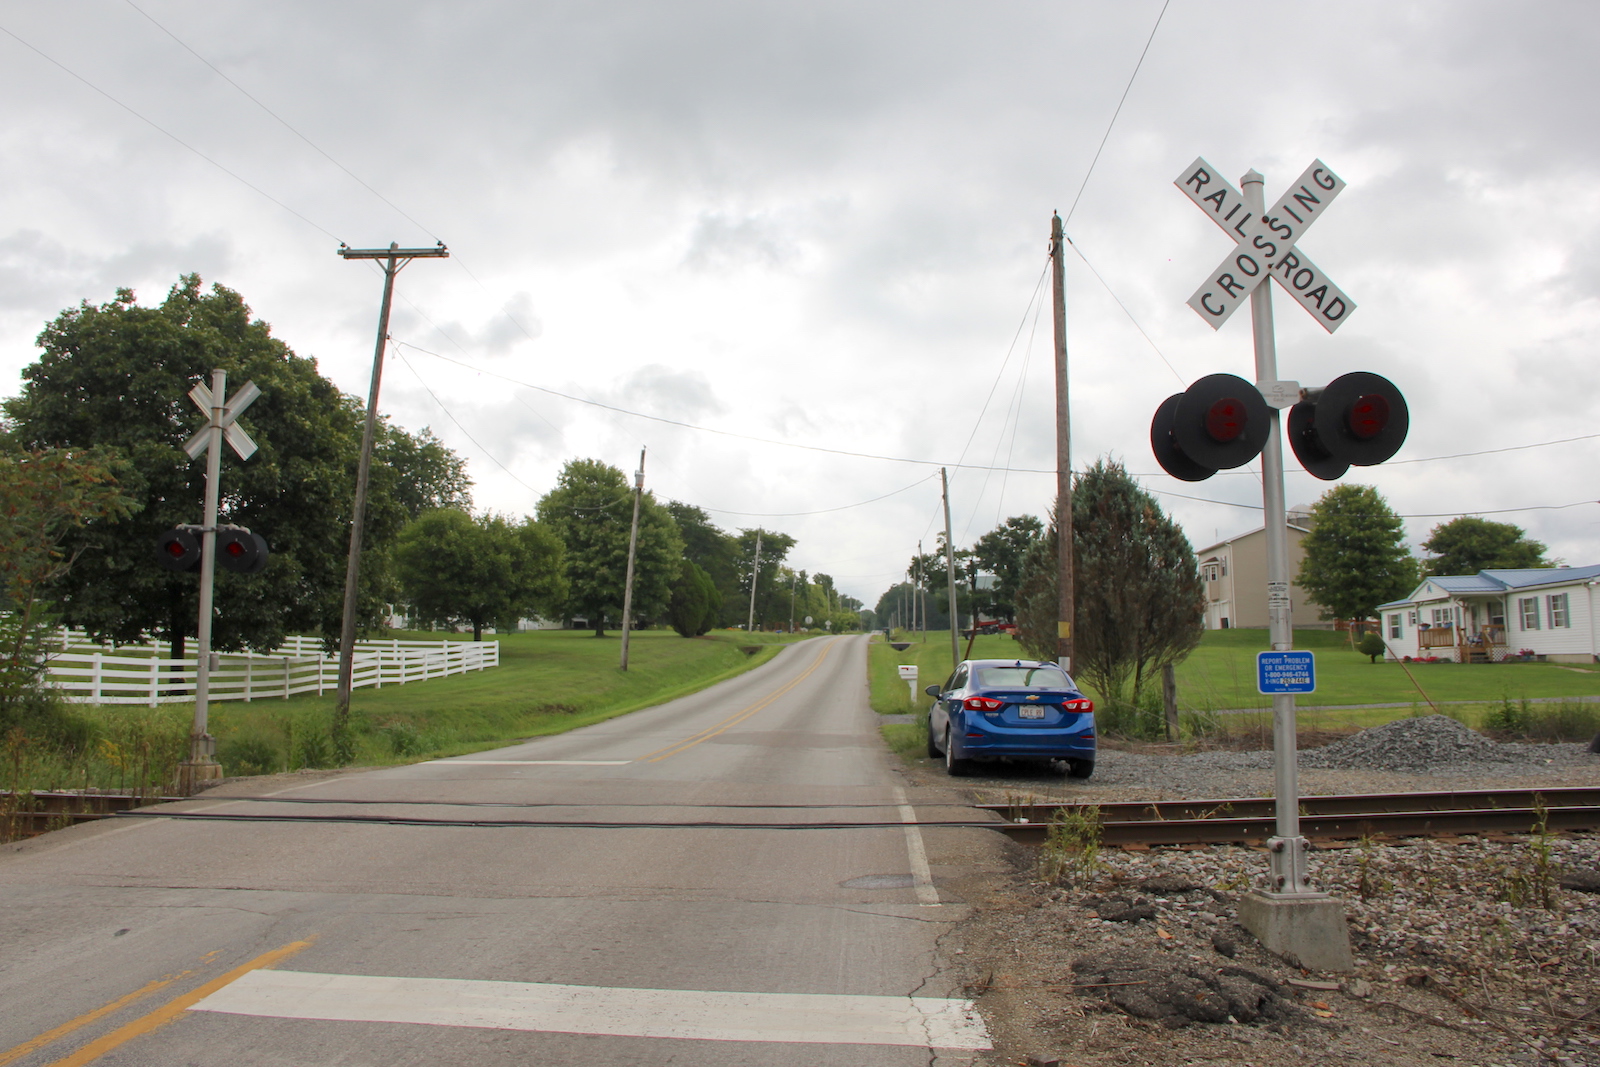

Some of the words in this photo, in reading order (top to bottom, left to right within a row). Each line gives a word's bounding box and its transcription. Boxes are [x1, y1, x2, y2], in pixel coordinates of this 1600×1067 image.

[1186, 167, 1252, 238] RAIL
[1275, 251, 1346, 321] ROAD
[1200, 168, 1336, 316] CROSSING
